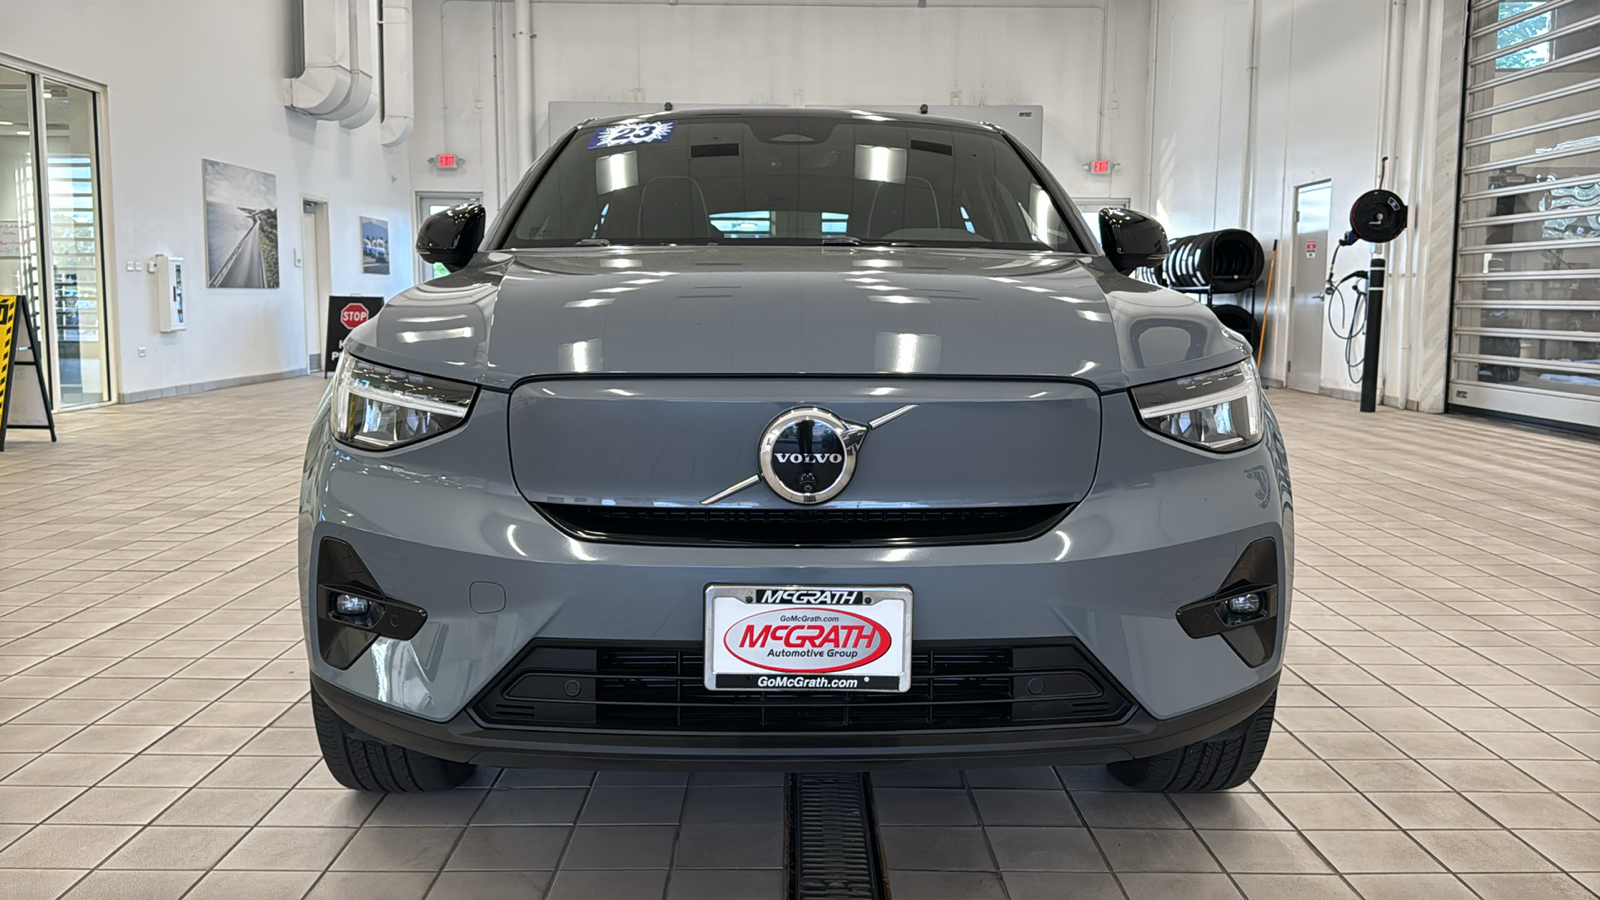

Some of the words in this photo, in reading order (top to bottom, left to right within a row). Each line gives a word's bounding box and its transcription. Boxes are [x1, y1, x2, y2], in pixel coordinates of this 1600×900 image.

[611, 126, 657, 141] 23
[342, 311, 367, 322] STOP
[774, 453, 842, 463] VOLVO
[780, 615, 839, 623] GoMcGrath.com
[767, 649, 824, 658] Automotive
[826, 649, 858, 659] Group
[757, 676, 858, 688] GoMcGrath.com
